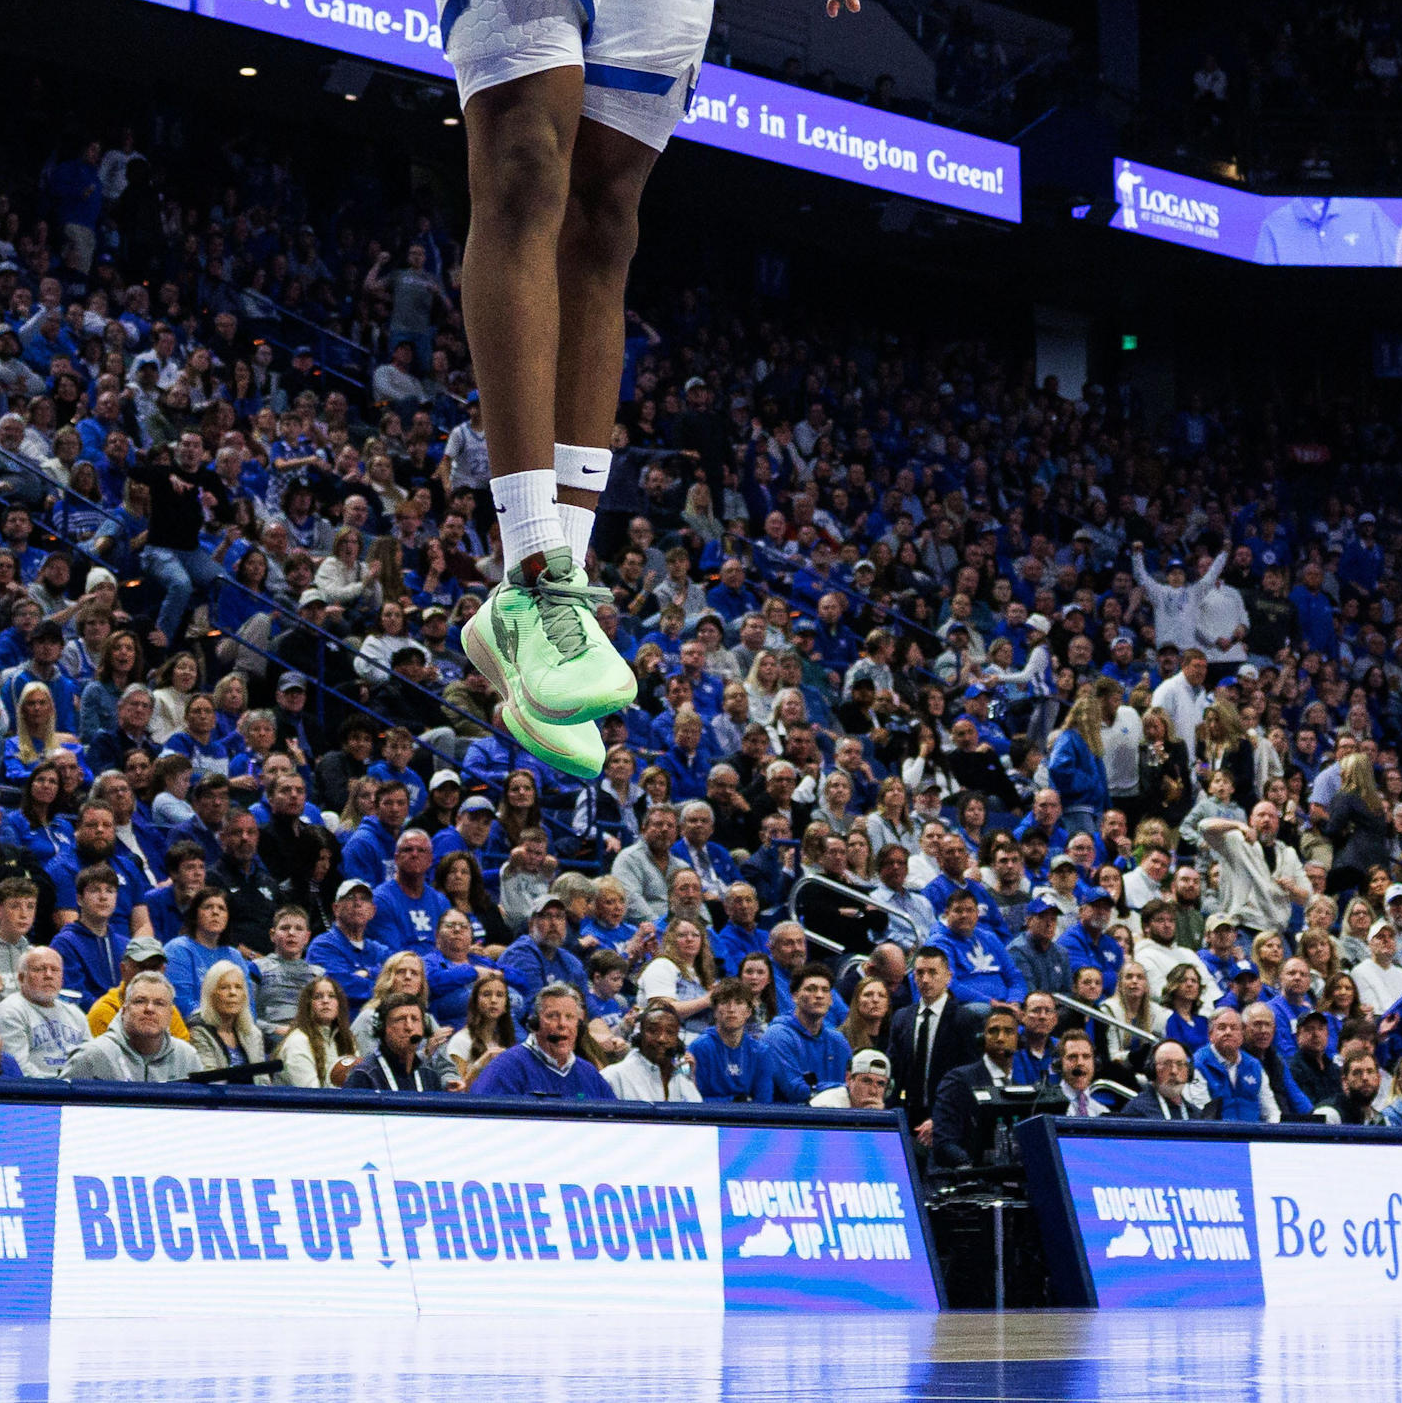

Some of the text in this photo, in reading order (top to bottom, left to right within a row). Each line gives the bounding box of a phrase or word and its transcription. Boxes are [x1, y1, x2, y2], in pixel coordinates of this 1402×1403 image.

[682, 94, 1004, 195] gan's in Lexington Green!
[1139, 186, 1220, 228] LOGAN'S
[73, 1175, 708, 1262] BUCKLE UP PHONE DOWN
[726, 1179, 906, 1220] BUCKLE PHONE
[1093, 1186, 1245, 1224] BUCKLE PHONE
[792, 1224, 911, 1261] UP DOWN
[1149, 1226, 1251, 1262] UP DOWN
[1273, 1195, 1327, 1258] Be
